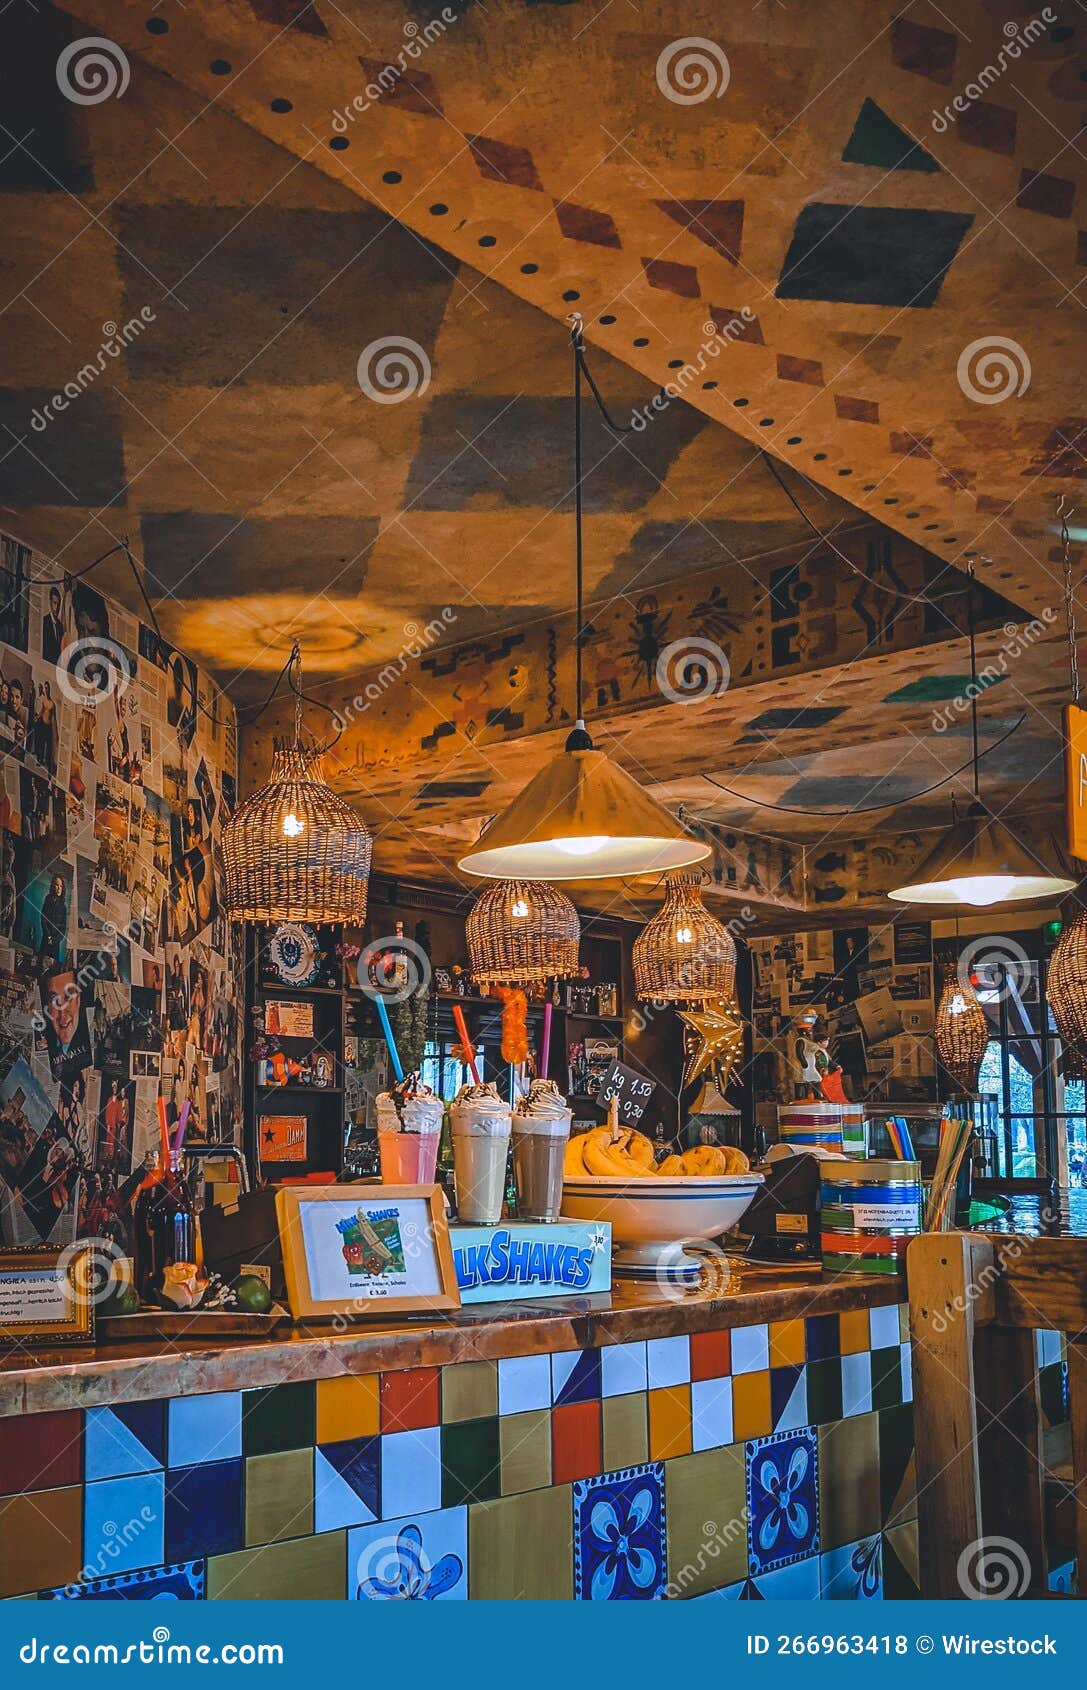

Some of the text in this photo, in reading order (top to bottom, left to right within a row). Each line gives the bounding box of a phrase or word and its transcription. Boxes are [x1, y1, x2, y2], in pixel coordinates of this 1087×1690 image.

[612, 1066, 652, 1097] kg 1,50
[624, 1101, 644, 1119] 0,30
[367, 1207, 400, 1222] SHAKES
[453, 1229, 594, 1289] LKSHAKES
